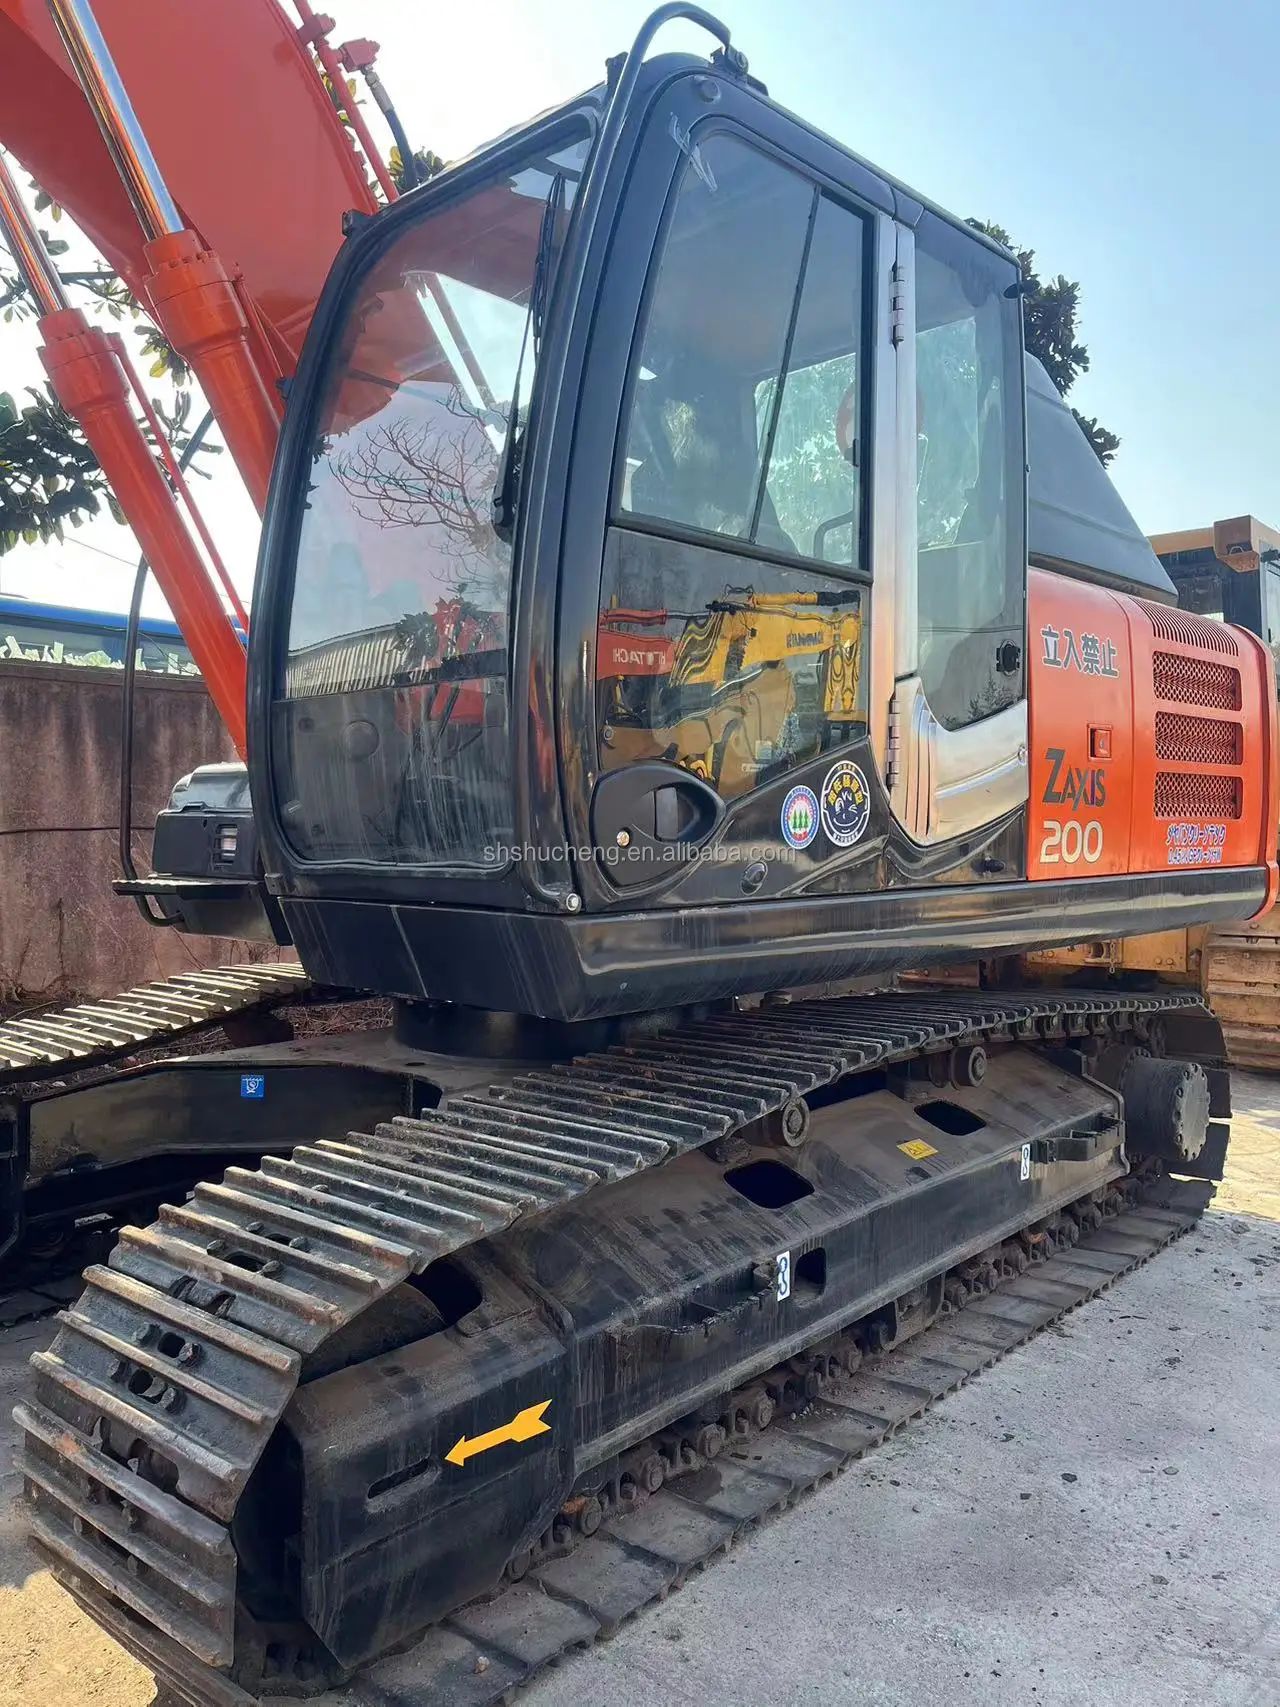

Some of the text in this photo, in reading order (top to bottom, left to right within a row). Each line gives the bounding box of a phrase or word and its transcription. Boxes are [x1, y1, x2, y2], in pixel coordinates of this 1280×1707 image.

[1040, 624, 1119, 678] 立入禁止
[1042, 748, 1106, 811] ZAXIS
[1040, 820, 1103, 864] 200
